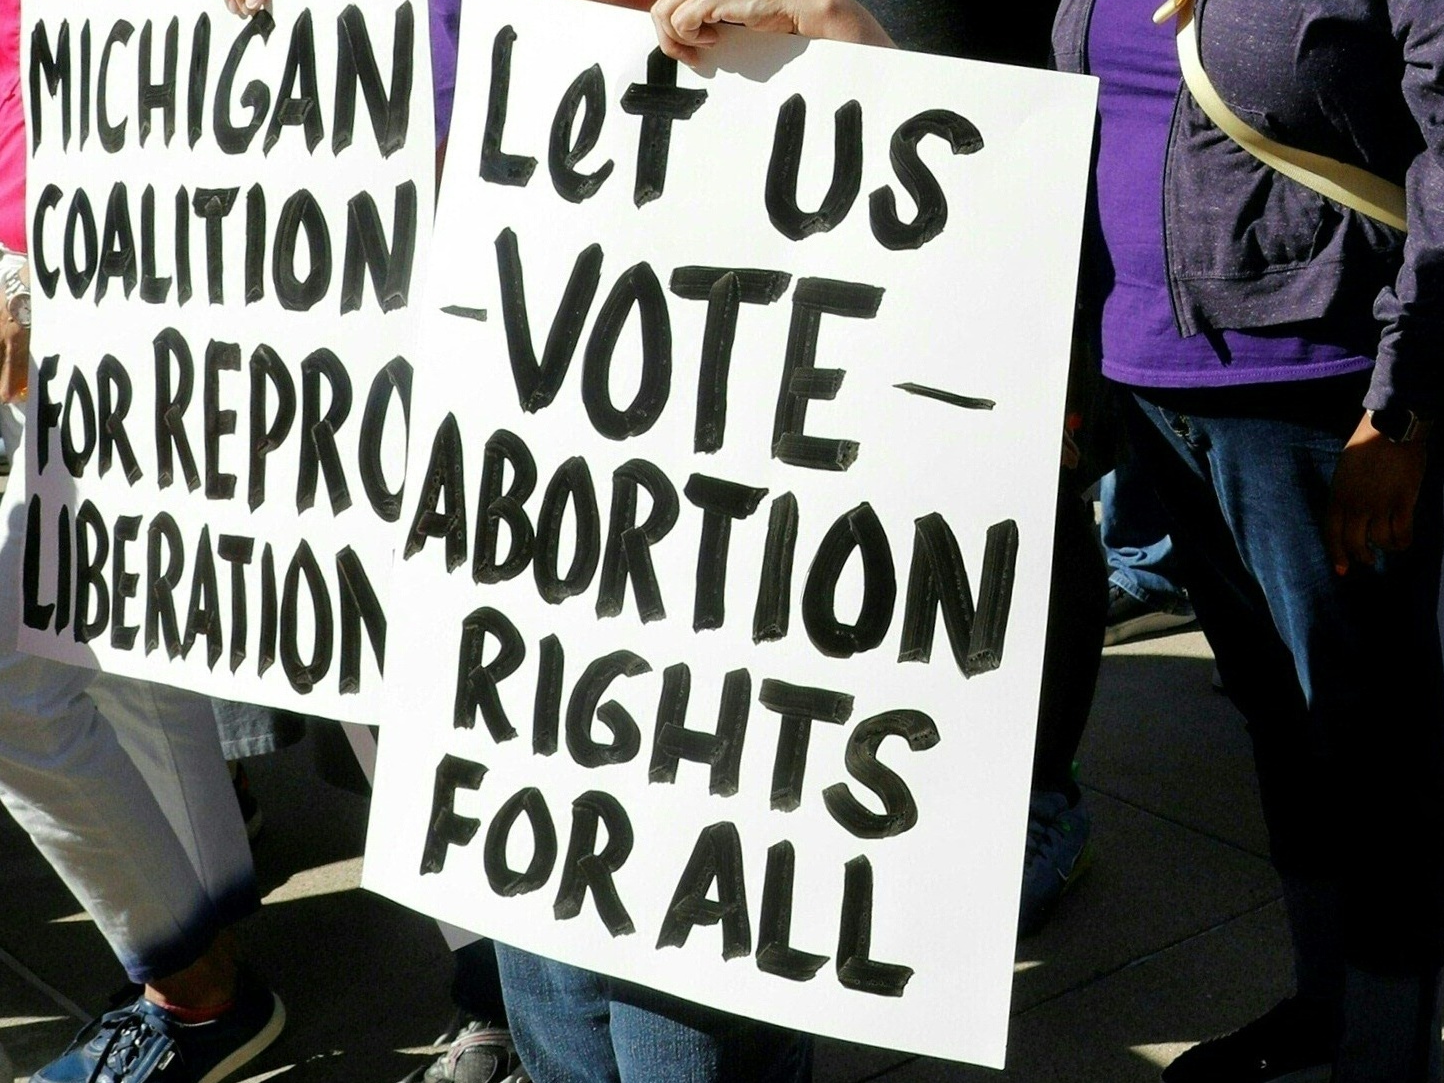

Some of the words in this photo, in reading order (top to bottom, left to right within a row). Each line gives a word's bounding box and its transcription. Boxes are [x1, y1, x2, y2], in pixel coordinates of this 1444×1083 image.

[31, 179, 417, 316] COALITION
[478, 23, 709, 211] Let
[763, 91, 986, 252] US
[34, 352, 143, 490] FOR
[151, 325, 415, 523] REPRO
[20, 492, 388, 696] LIBERATION
[403, 411, 1021, 680] ABORTION
[452, 606, 942, 840] RIGHTS
[419, 752, 637, 939] FOR
[654, 820, 916, 998] ALL
